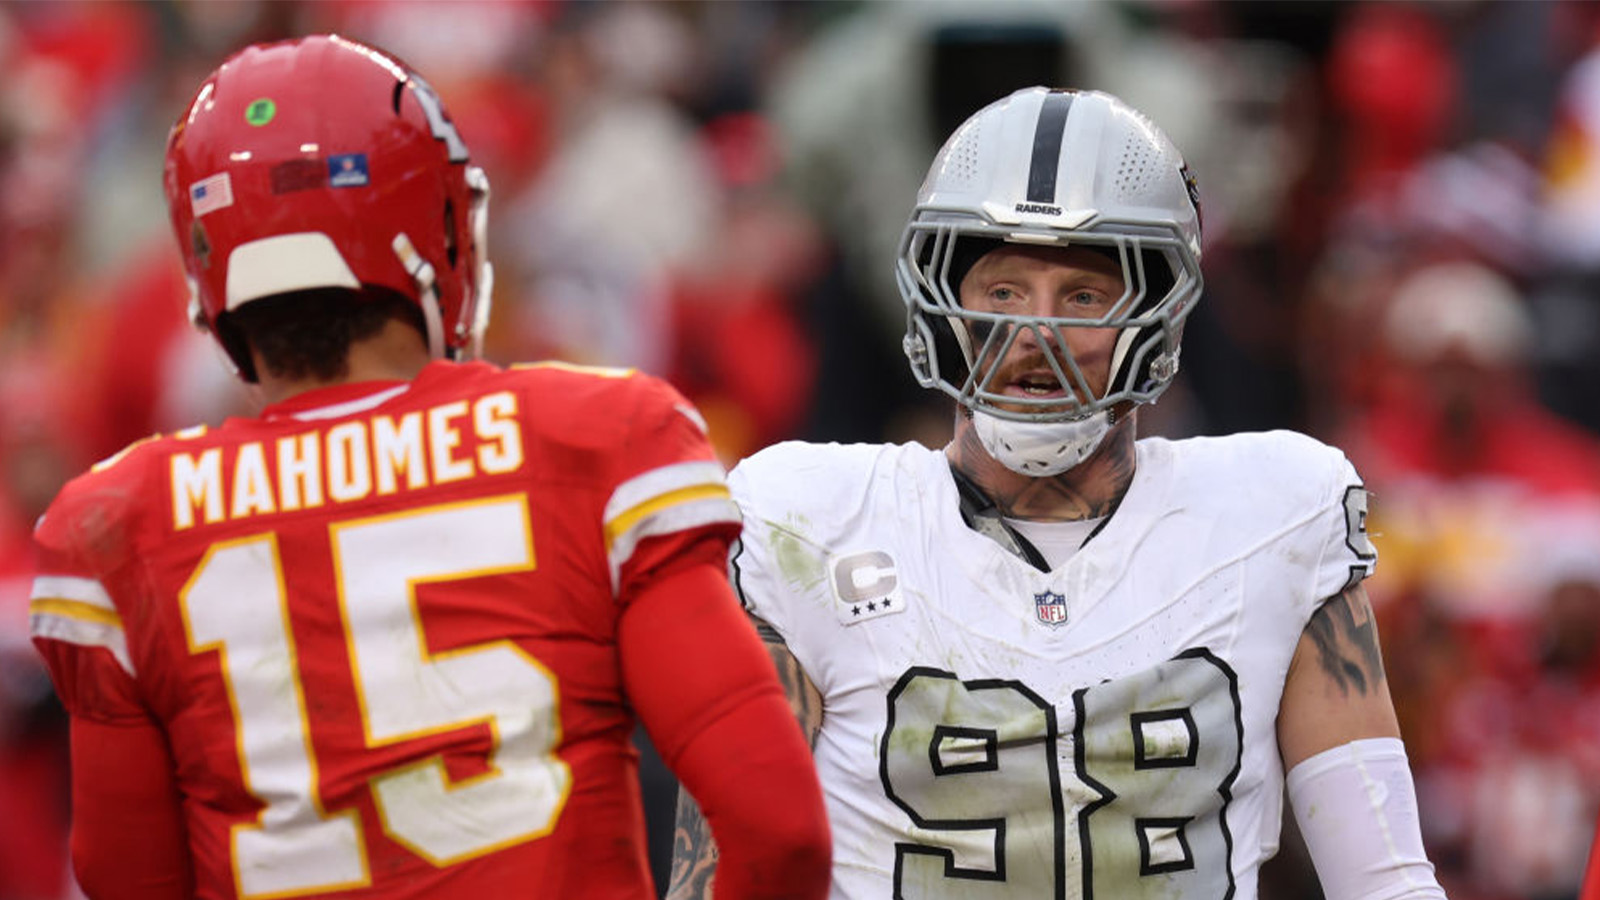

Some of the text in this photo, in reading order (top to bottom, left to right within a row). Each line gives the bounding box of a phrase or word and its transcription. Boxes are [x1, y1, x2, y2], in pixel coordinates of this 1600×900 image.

[1015, 203, 1062, 216] RAIDERS
[171, 391, 524, 531] MAHOMES
[835, 551, 897, 604] C
[1040, 605, 1065, 622] NFL
[178, 492, 573, 900] 15
[880, 646, 1244, 900] 98
